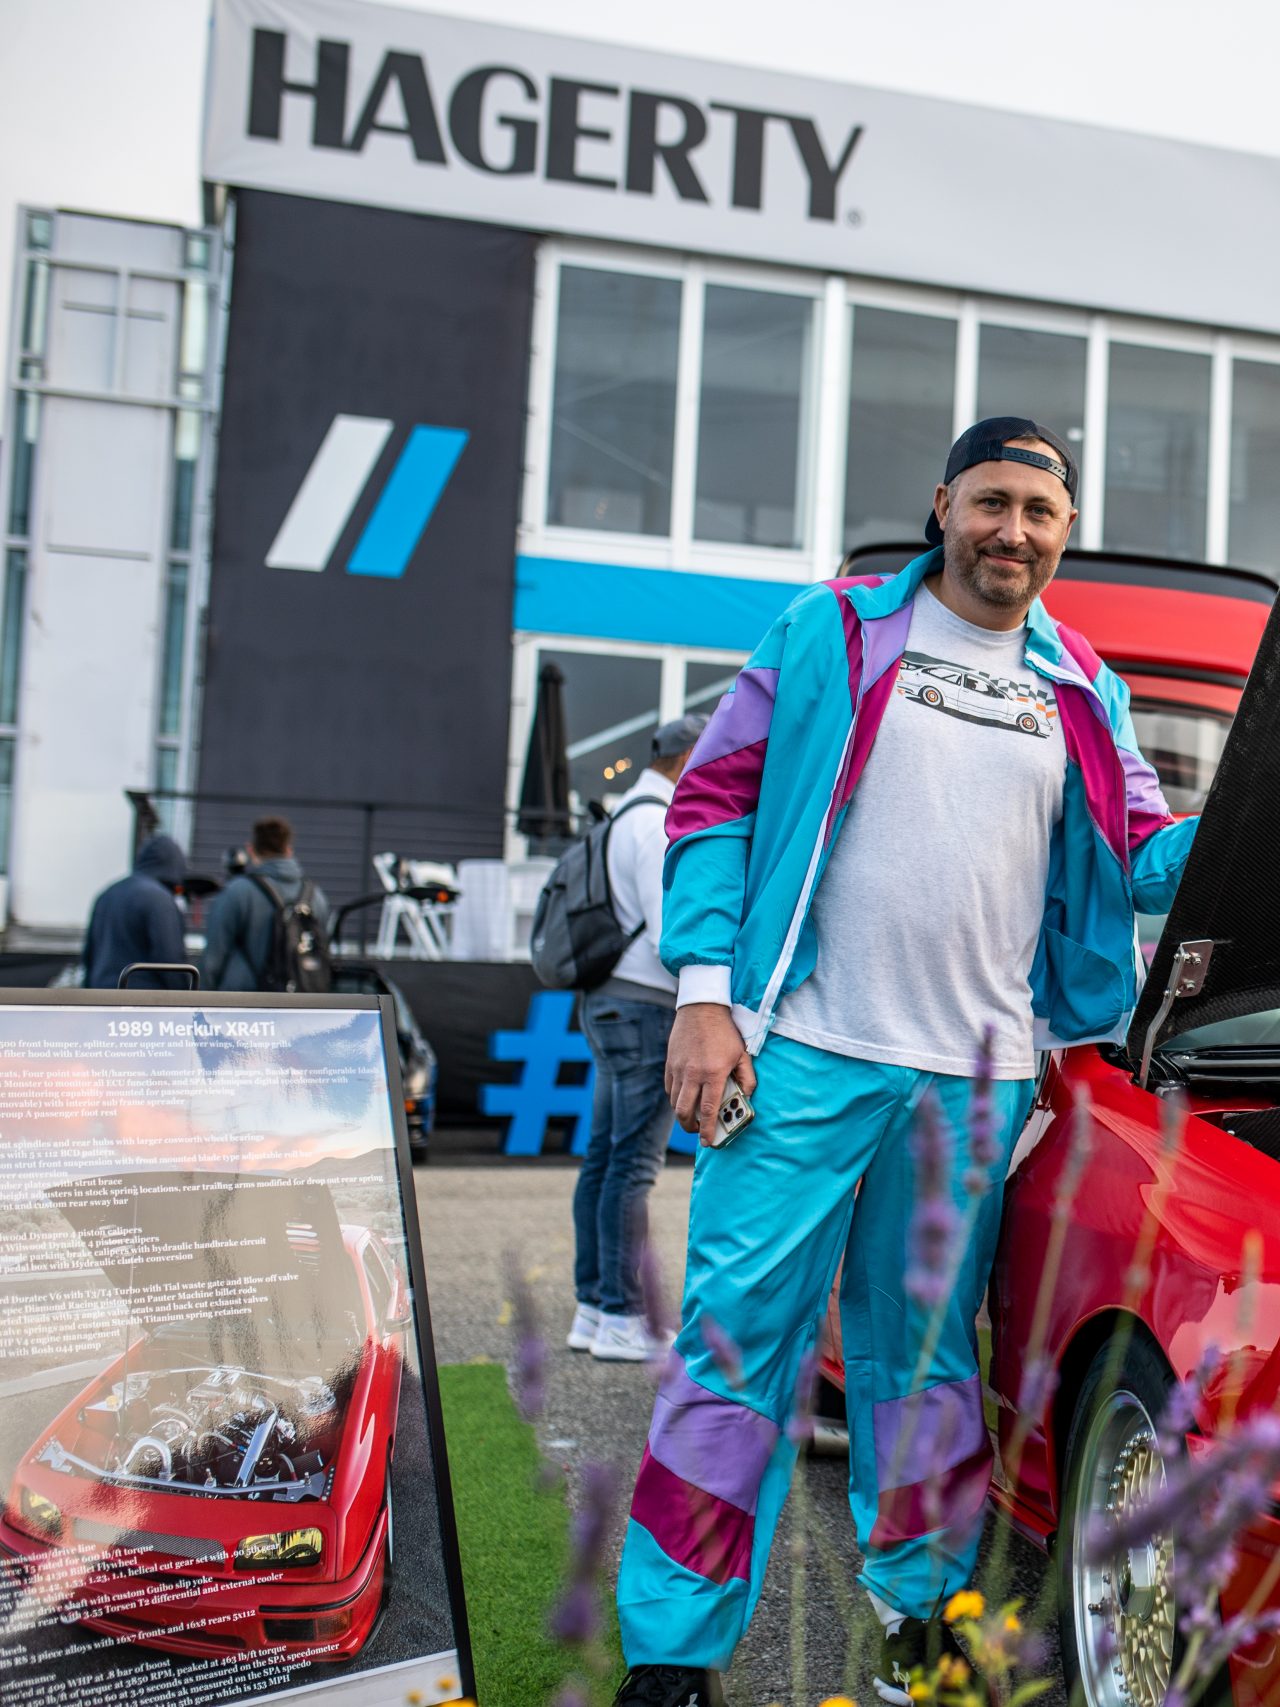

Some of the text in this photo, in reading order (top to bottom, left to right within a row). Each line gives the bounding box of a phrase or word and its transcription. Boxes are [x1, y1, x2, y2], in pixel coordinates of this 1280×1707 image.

[247, 26, 865, 222] HAGERTY
[107, 1021, 276, 1037] 1989 Merkur XR4Ti
[52, 1049, 73, 1057] with
[75, 1049, 102, 1057] Escort
[104, 1049, 145, 1057] Cosworth
[140, 1041, 165, 1050] upper
[74, 1188, 83, 1196] in
[85, 1187, 108, 1195] stock
[110, 1186, 138, 1197] spring
[202, 1181, 233, 1191] trailing
[256, 1178, 291, 1187] modified
[294, 1178, 304, 1186] for
[306, 1177, 325, 1187] drop
[98, 1177, 122, 1185] brace
[90, 1199, 111, 1207] sway
[113, 1197, 128, 1205] bar
[78, 1228, 106, 1239] piston
[131, 1244, 150, 1253] with
[152, 1241, 192, 1253] hydraulic
[194, 1238, 239, 1249] handbrake
[240, 1236, 266, 1246] circuit
[146, 1252, 193, 1262] conversion
[49, 1291, 62, 1300] V6
[113, 1285, 140, 1295] Turbo
[142, 1283, 161, 1292] with
[182, 1281, 205, 1289] waste
[208, 1279, 224, 1289] gate
[226, 1276, 241, 1286] and
[244, 1275, 263, 1284] Blow
[265, 1273, 277, 1283] off
[278, 1273, 298, 1282] valve
[147, 1293, 175, 1302] Pauter
[177, 1289, 214, 1299] Machine
[215, 1287, 236, 1296] billet
[239, 1285, 256, 1294] rods
[132, 1305, 153, 1313] seats
[155, 1302, 171, 1311] and
[173, 1300, 193, 1310] back
[195, 1300, 208, 1308] cut
[210, 1297, 242, 1307] exhaust
[243, 1294, 268, 1304] valves
[144, 1312, 184, 1323] Titanium
[186, 1309, 213, 1320] spring
[215, 1306, 252, 1316] retainers
[124, 1545, 154, 1556] torque
[96, 1555, 137, 1572] Flywheel
[128, 1562, 157, 1576] helical
[160, 1561, 173, 1570] cut
[175, 1558, 194, 1570] gear
[90, 1593, 110, 1604] with
[112, 1589, 144, 1601] custom
[147, 1582, 174, 1594] Guibo
[176, 1578, 191, 1589] slip
[193, 1574, 213, 1588] yoke
[37, 1572, 284, 1627] rear Torsen T2 differential and external cooler
[65, 1644, 92, 1655] alloys
[94, 1637, 114, 1649] with
[138, 1629, 165, 1641] fronts
[167, 1622, 184, 1634] and
[186, 1618, 206, 1630] 16x8
[208, 1615, 231, 1625] rears
[233, 1609, 256, 1622] 5x112
[67, 1674, 92, 1686] WHP
[94, 1672, 104, 1681] at
[117, 1667, 133, 1676] bar
[134, 1662, 144, 1673] of
[145, 1658, 170, 1670] boost
[69, 1687, 78, 1697] of
[80, 1683, 112, 1695] torque
[114, 1679, 124, 1688] at
[177, 1660, 208, 1678] peaked
[210, 1659, 219, 1668] at
[238, 1650, 257, 1662] lb/ft
[258, 1645, 286, 1657] torque
[92, 1697, 102, 1705] to
[118, 1690, 129, 1699] at
[146, 1678, 182, 1693] seconds
[184, 1676, 193, 1684] as
[195, 1664, 238, 1681] measured
[240, 1663, 251, 1671] on
[252, 1659, 266, 1669] the
[268, 1653, 286, 1665] SPA
[287, 1643, 339, 1663] speedometer
[140, 1690, 176, 1705] seconds
[190, 1676, 233, 1693] measured
[235, 1675, 246, 1683] on
[248, 1670, 262, 1680] the
[263, 1665, 281, 1676] SPA
[282, 1659, 311, 1674] speedo
[195, 1673, 290, 1706] gear which is 153 MPH
